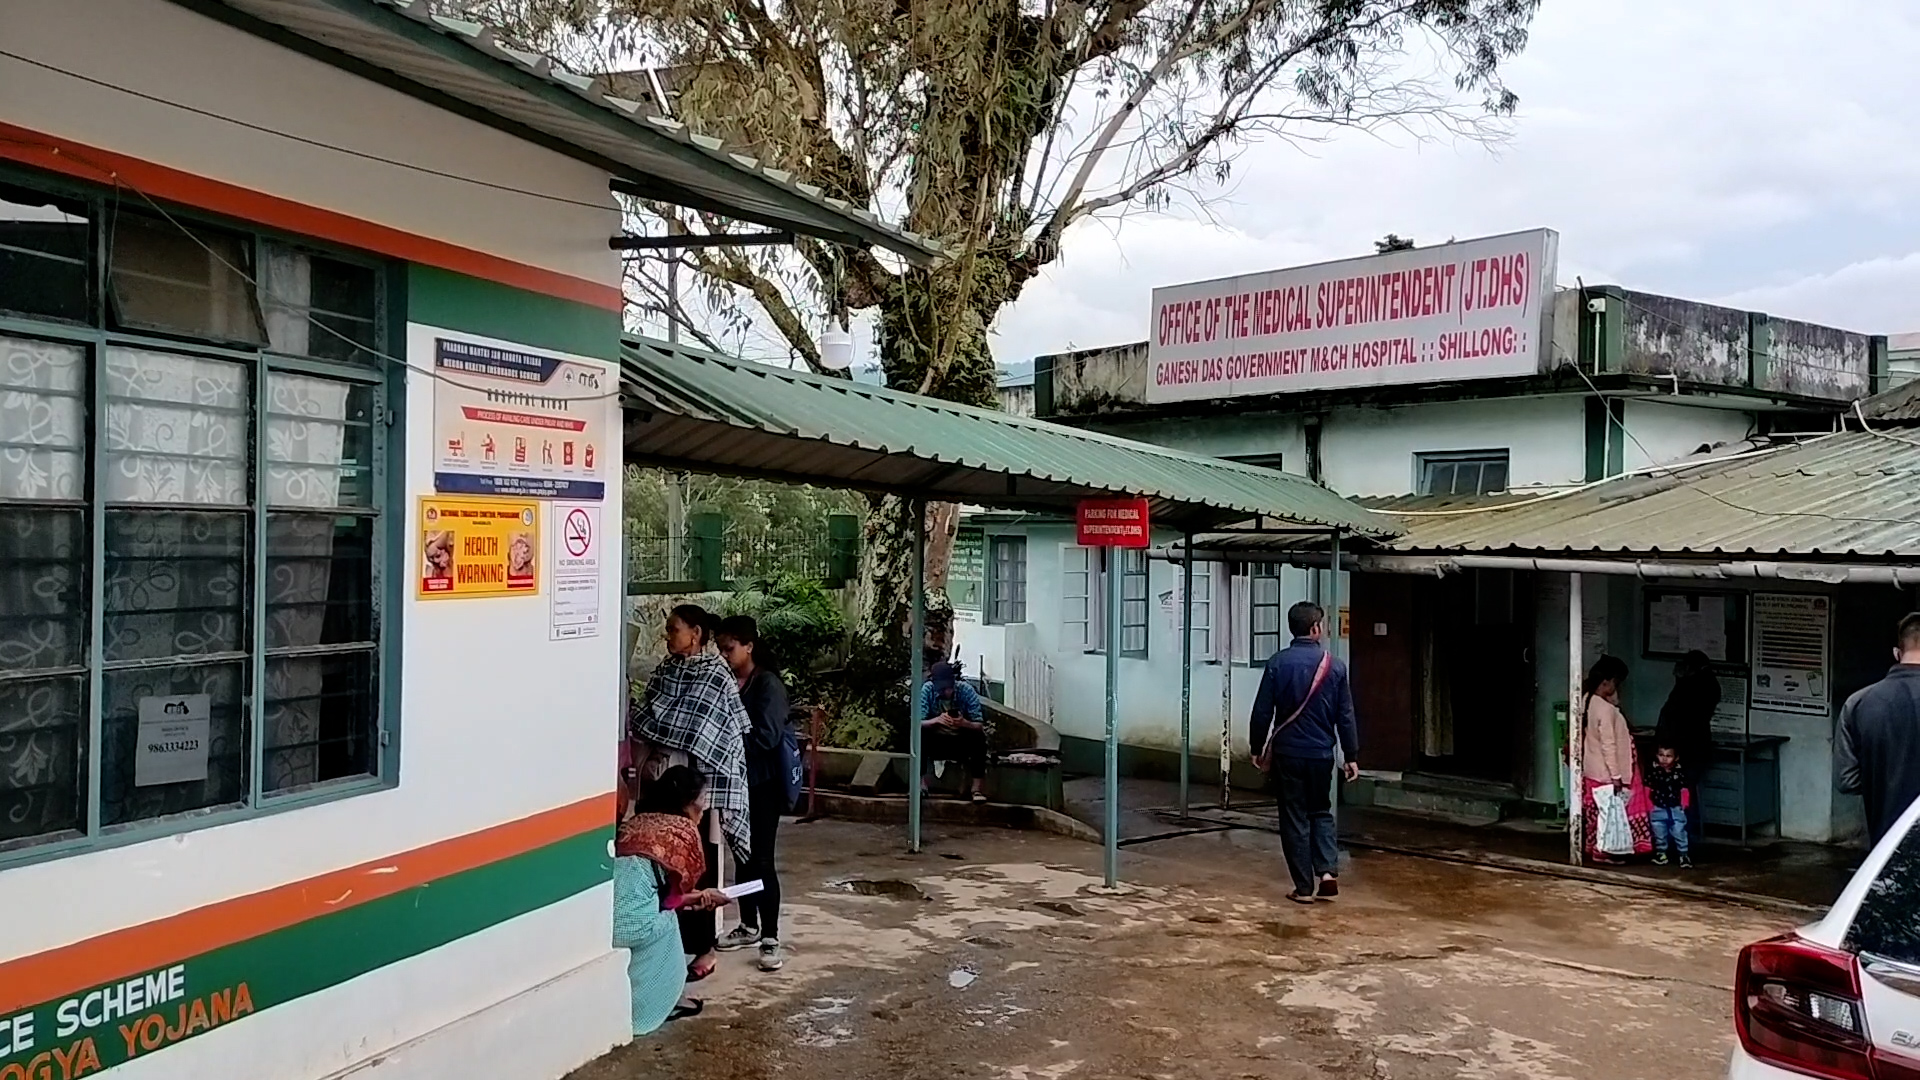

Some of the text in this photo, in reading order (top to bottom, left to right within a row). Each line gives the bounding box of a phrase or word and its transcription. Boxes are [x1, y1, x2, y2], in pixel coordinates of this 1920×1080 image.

[1159, 252, 1530, 346] OFFICE OF THE MEDICAL SUPERINTENDENT (JT.DHS)
[1156, 360, 1199, 386] GANESH
[1202, 357, 1223, 382] DAS
[1226, 349, 1307, 380] GOVERNMENT
[1310, 345, 1349, 372] M&CH
[1352, 337, 1418, 369] HOSPITAL
[1084, 508, 1140, 520] PARKING FOR MEDICAL
[464, 536, 498, 556] HEALTH
[457, 564, 503, 584] WARNING
[148, 740, 199, 754] 9863334223
[57, 964, 185, 1038] SCHEME
[119, 982, 254, 1057] YOJANA
